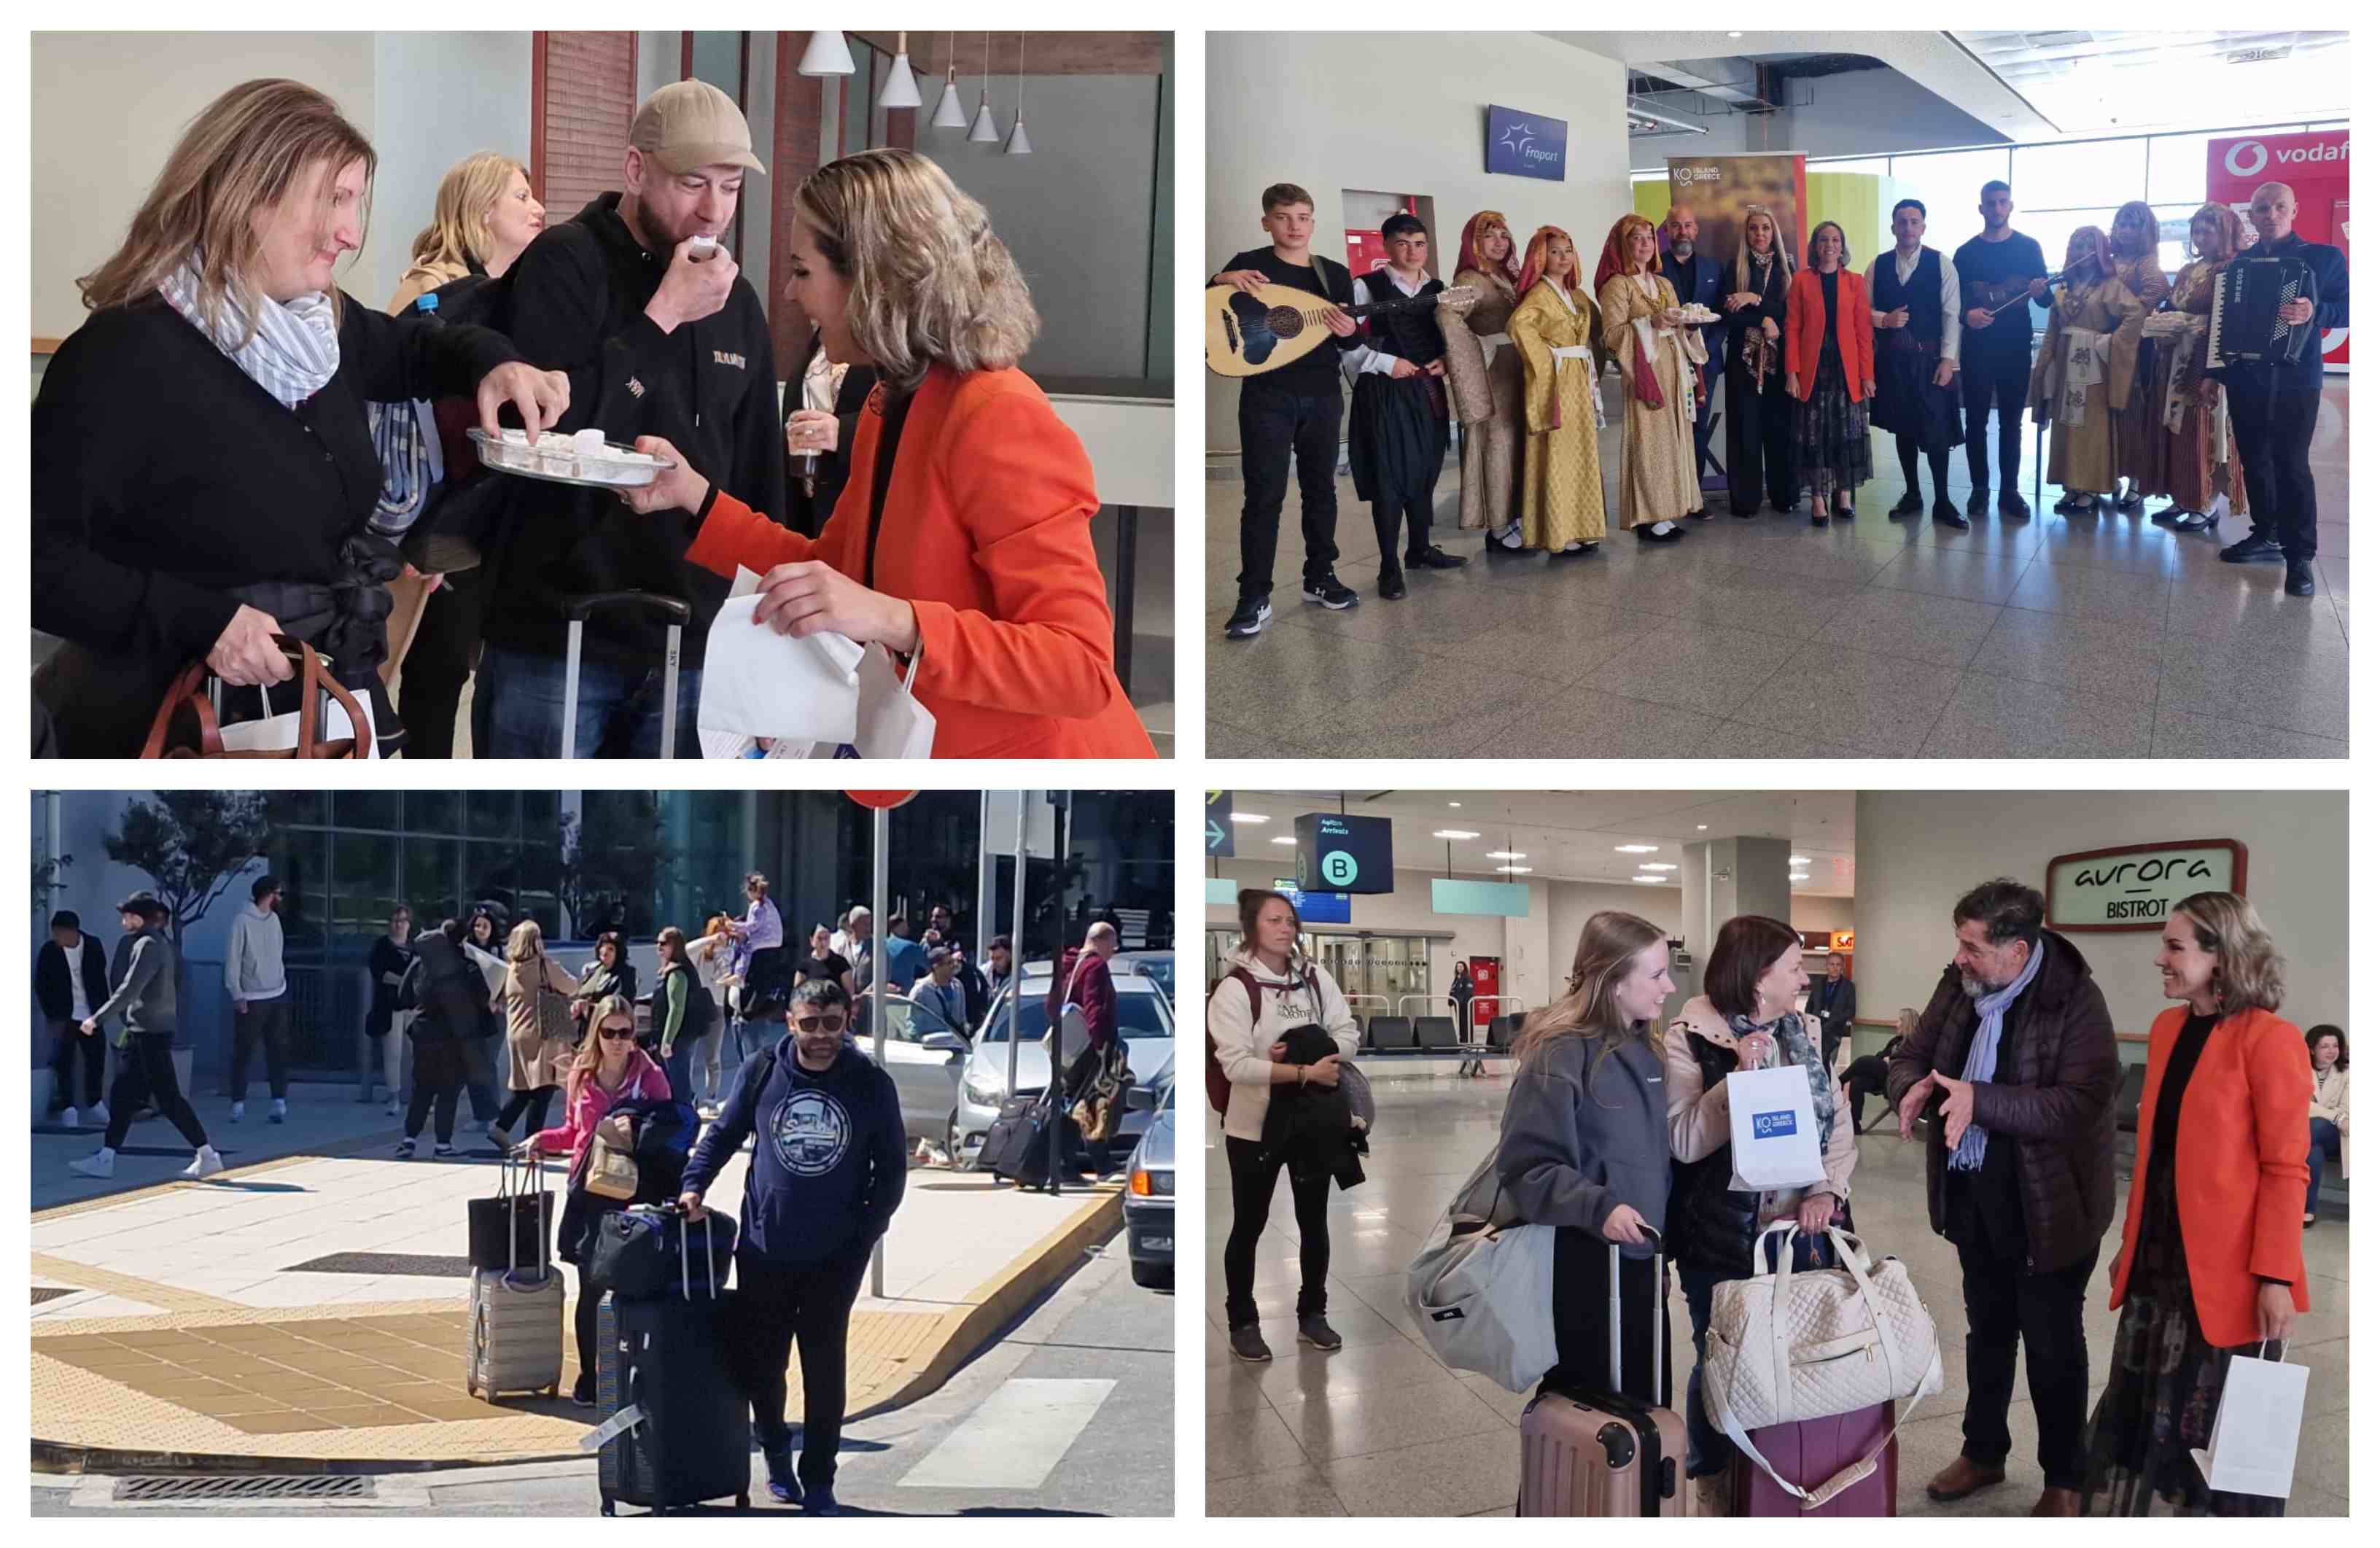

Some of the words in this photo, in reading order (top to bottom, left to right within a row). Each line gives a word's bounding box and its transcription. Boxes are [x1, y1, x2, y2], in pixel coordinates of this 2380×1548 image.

[1525, 145, 1558, 163] Fraport
[1321, 827, 1348, 835] Arrivals
[1332, 859, 1348, 878] B
[2107, 898, 2169, 919] BISTROT
